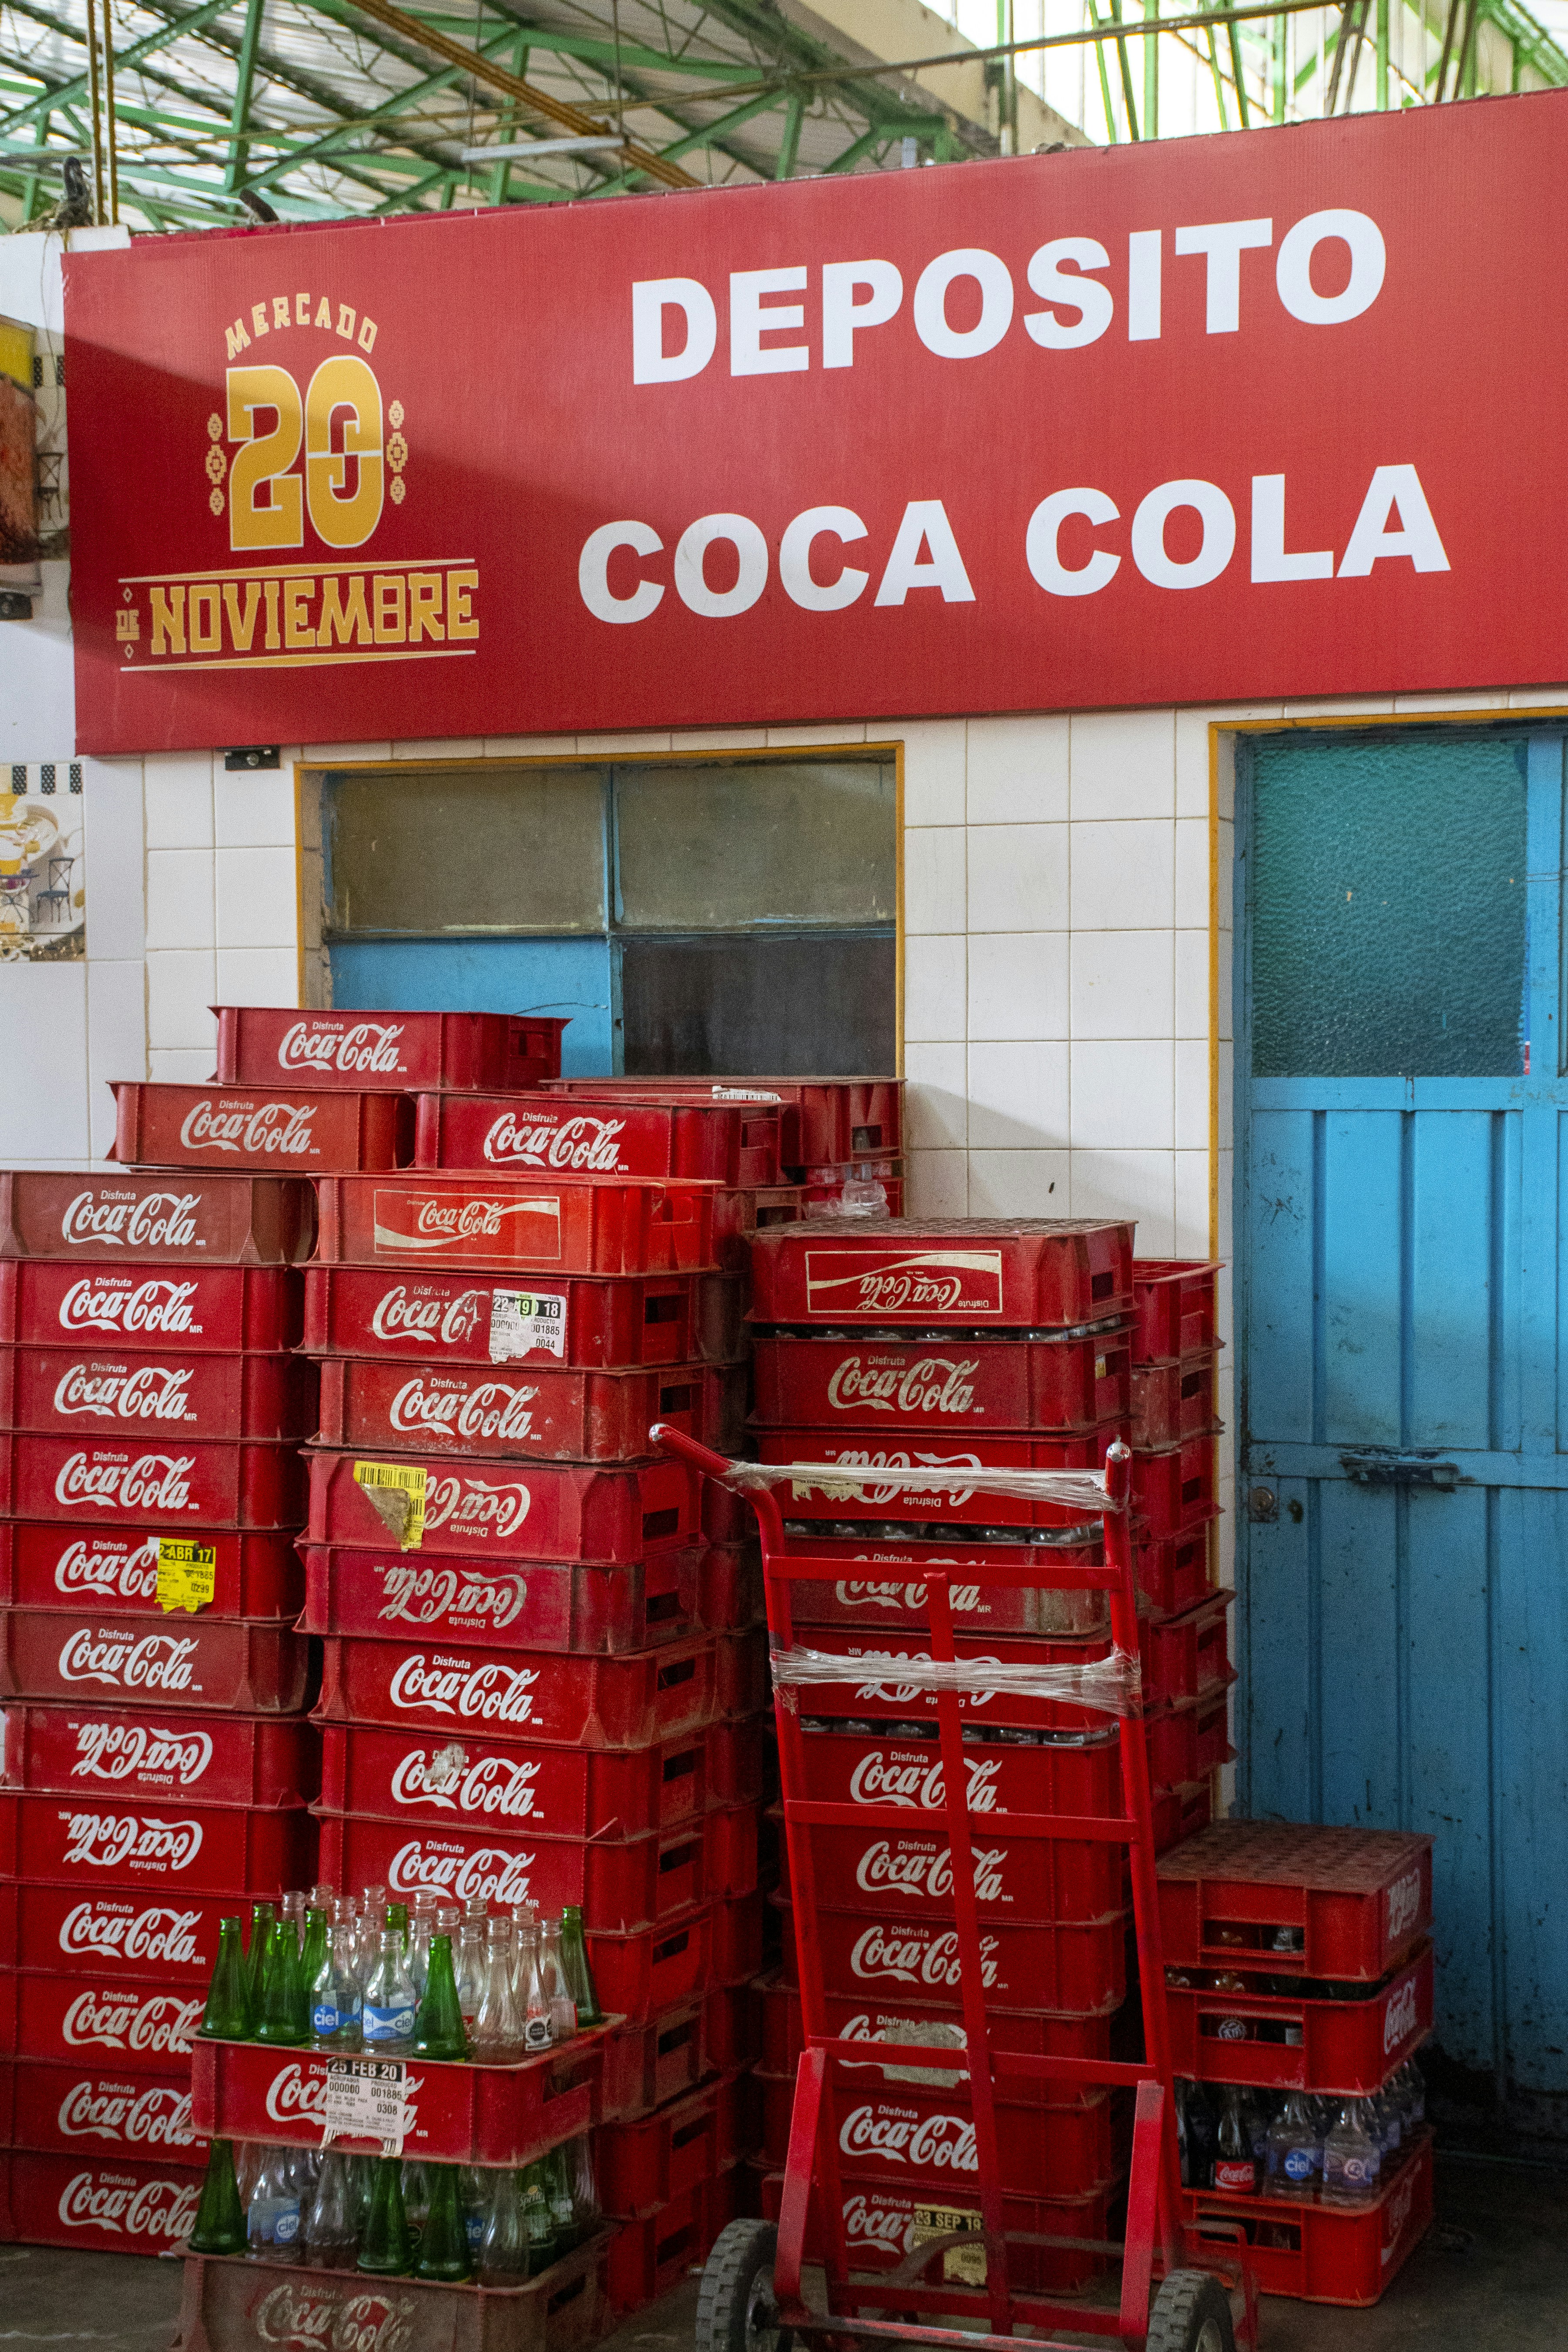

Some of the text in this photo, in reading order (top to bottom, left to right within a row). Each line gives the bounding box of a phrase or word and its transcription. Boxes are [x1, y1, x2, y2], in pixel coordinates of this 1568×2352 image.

[632, 208, 1387, 385] DEPOSITO
[225, 293, 378, 360] MERCADO
[226, 355, 384, 550] 20
[578, 463, 1451, 624] COCA COLA
[116, 570, 480, 654] DE NOVIEMBRE
[312, 1021, 344, 1031] Disfruta
[278, 1022, 406, 1072] Coca-Cola
[218, 1100, 254, 1110] Disfruta
[180, 1101, 318, 1153] Coca-Cola
[483, 1112, 626, 1171] Coca-Cola
[101, 1190, 136, 1201] Disfruta
[62, 1191, 202, 1246] Coca-Cola
[418, 1200, 504, 1235] Coca-Cola
[94, 1277, 132, 1287] Disfruta
[856, 1276, 962, 1310] Coca-Cola
[59, 1278, 203, 1333] Coca-Cola MR
[493, 1296, 509, 1312] 22
[544, 1302, 559, 1317] 18
[958, 1299, 989, 1308] Disfrute
[536, 1338, 555, 1349] 0044
[91, 1362, 127, 1373] Disfruta
[868, 1355, 906, 1366] Disfruta
[430, 1377, 468, 1390] Disfruta
[828, 1356, 980, 1413] Coca-Cola
[54, 1364, 197, 1421] Coca-Cola MR
[390, 1378, 540, 1440] Coca-Cola
[93, 1451, 129, 1462] Disfruta
[55, 1452, 197, 1509] Coca-Cola
[903, 1496, 942, 1507] Disfruta
[450, 1523, 488, 1537] Disfruta
[93, 1540, 128, 1551] Disfruta
[167, 1545, 193, 1561] ABR
[198, 1549, 212, 1563] 17
[377, 1566, 527, 1629] Coca-Cola
[977, 1605, 991, 1614] MR
[448, 1616, 487, 1629] Disfruta
[98, 1628, 134, 1641] Disfruta
[59, 1628, 200, 1690] Coca-Cola
[848, 1647, 862, 1655] MR
[432, 1655, 471, 1669] Disfruta
[390, 1654, 541, 1722] Coca-Cola
[71, 1723, 213, 1785] Coca-Cola
[890, 1751, 929, 1763] Disfruta
[138, 1771, 174, 1785] Disfruta
[62, 1813, 203, 1871] Coca-Cola
[426, 1840, 465, 1854] Disfruta
[897, 1840, 937, 1852] Disfruta
[129, 1859, 168, 1872] Disfruta
[389, 1841, 540, 1908] Coca-Cola MR
[96, 1900, 134, 1914] Disfruta
[58, 1902, 206, 1965] Coca-Cola MR
[891, 1925, 930, 1939] Disfruta
[102, 1990, 139, 2003] Disfruta
[314, 2007, 339, 2027] ciel
[331, 2060, 397, 2080] 25 FEB 20
[329, 2082, 402, 2100] 000000 001885
[377, 2103, 397, 2115] 0308
[877, 2104, 918, 2119] Disfruta
[416, 2129, 428, 2137] MR
[935, 2213, 962, 2230] SEP
